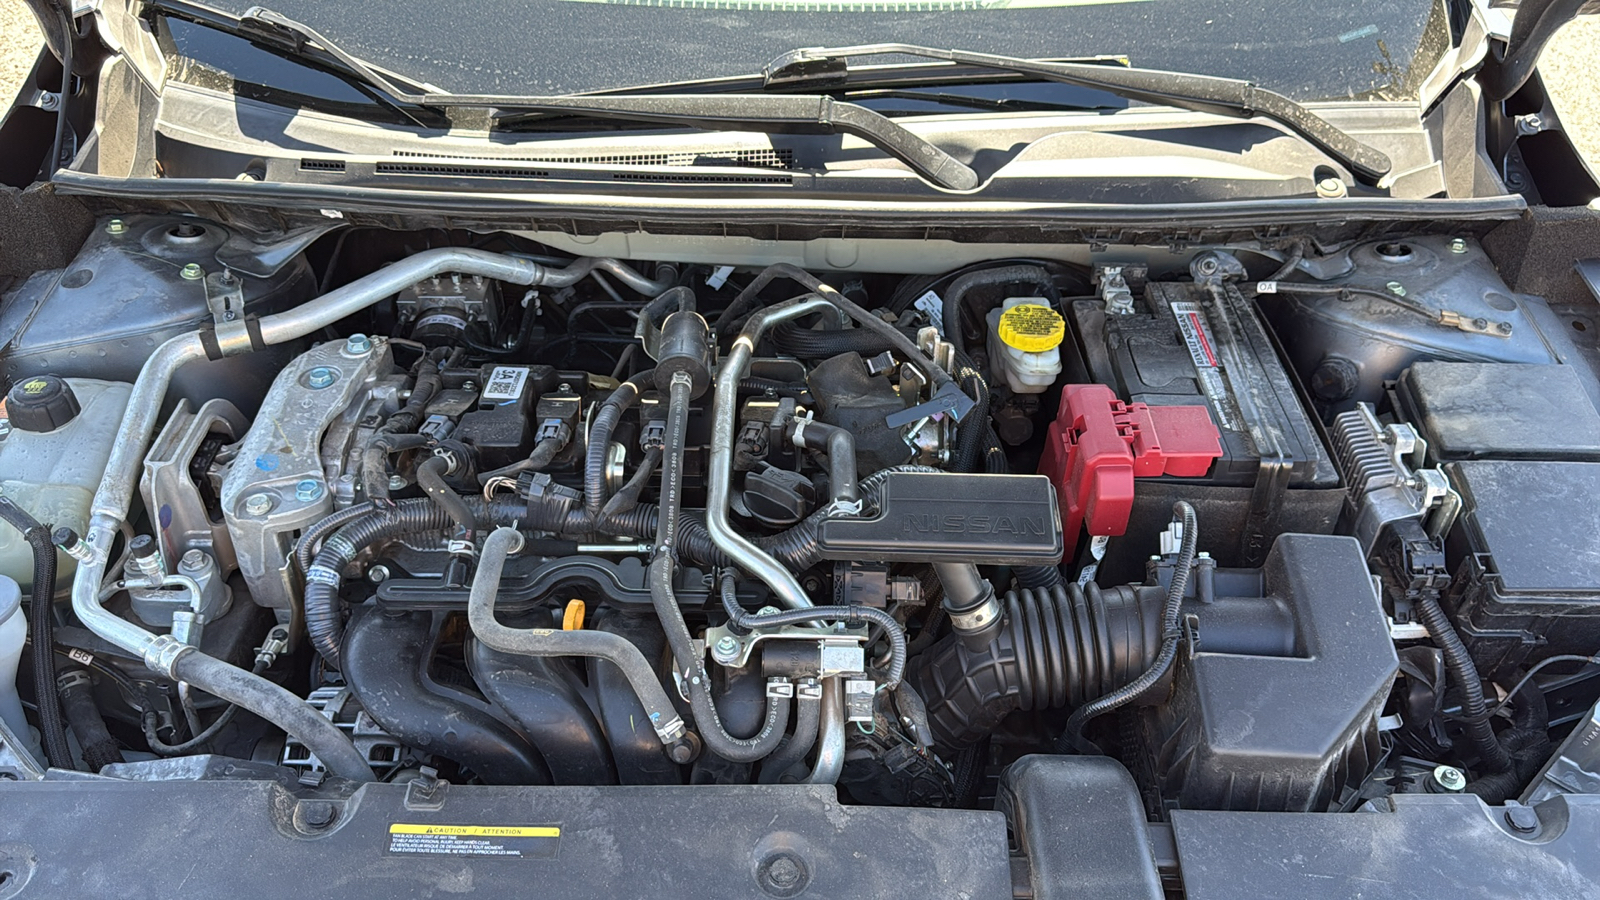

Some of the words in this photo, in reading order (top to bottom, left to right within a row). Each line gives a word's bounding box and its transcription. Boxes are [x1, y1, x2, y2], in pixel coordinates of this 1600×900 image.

[1178, 313, 1194, 340] NISSAN
[500, 370, 516, 380] 3A
[904, 514, 1046, 534] NISSAN
[73, 650, 90, 662] B6
